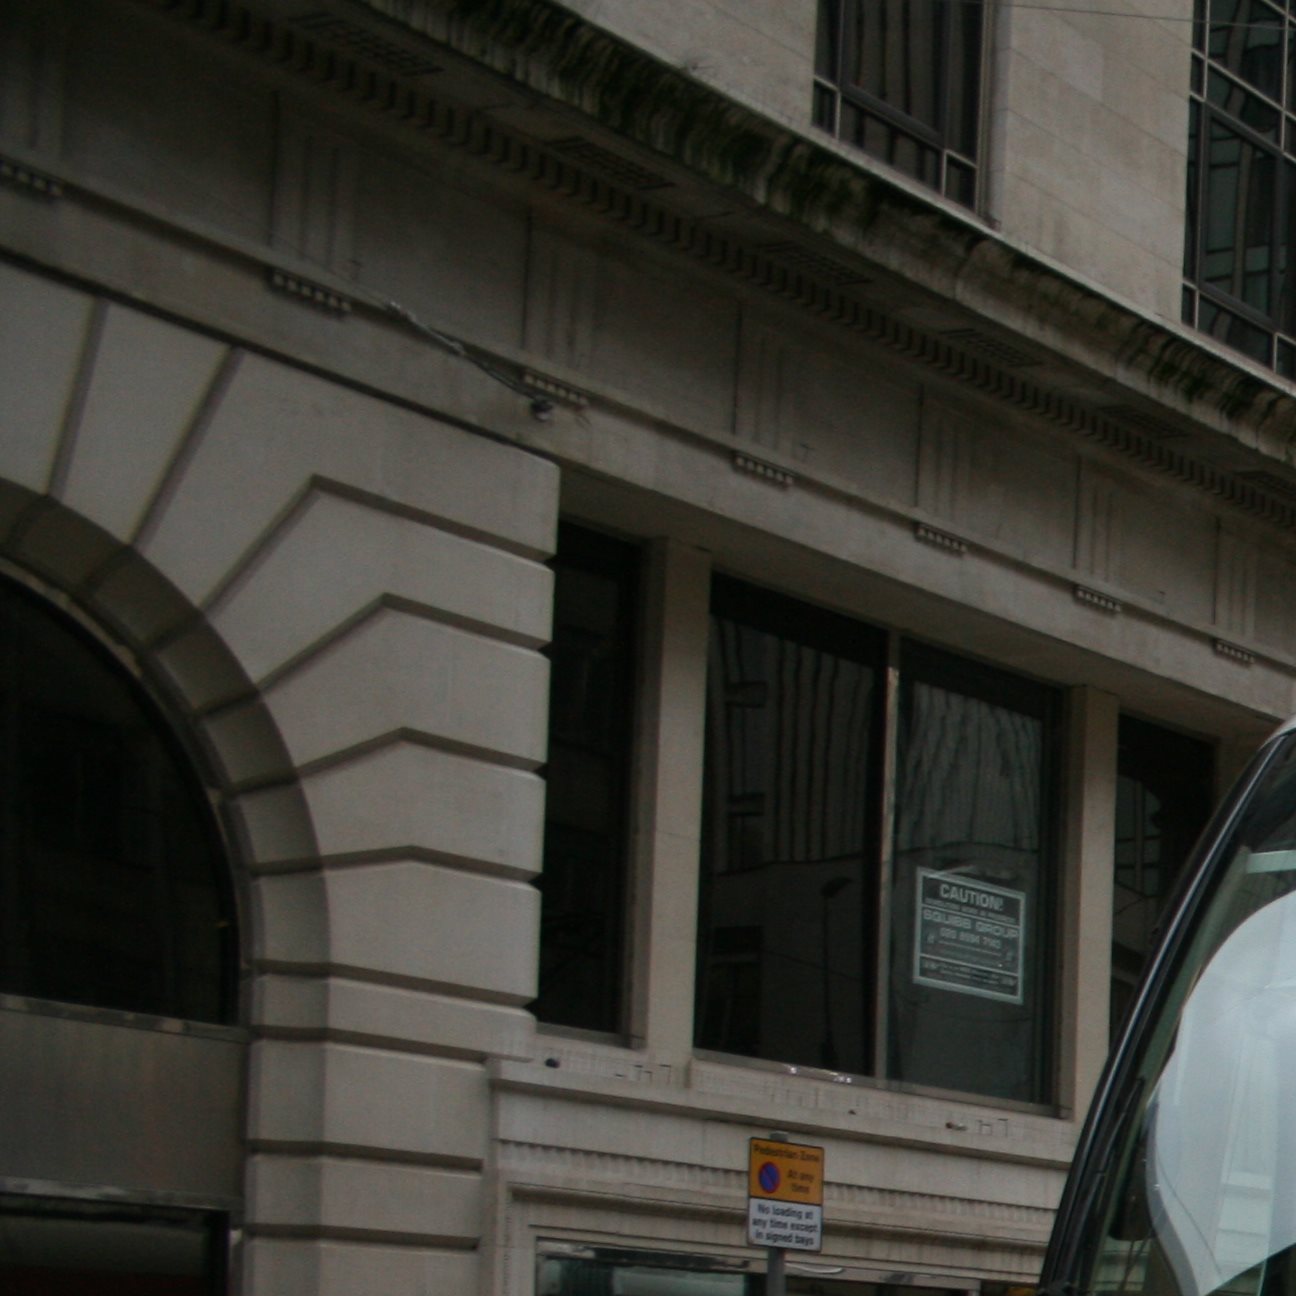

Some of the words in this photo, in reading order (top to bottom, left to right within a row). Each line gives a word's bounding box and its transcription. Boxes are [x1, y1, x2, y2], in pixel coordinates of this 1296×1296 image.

[757, 1203, 770, 1214] No
[772, 1206, 803, 1219] loading
[752, 1218, 767, 1229] any
[769, 1218, 788, 1229] time
[790, 1222, 819, 1234] except
[765, 1232, 793, 1244] signed
[795, 1235, 815, 1246] bays
